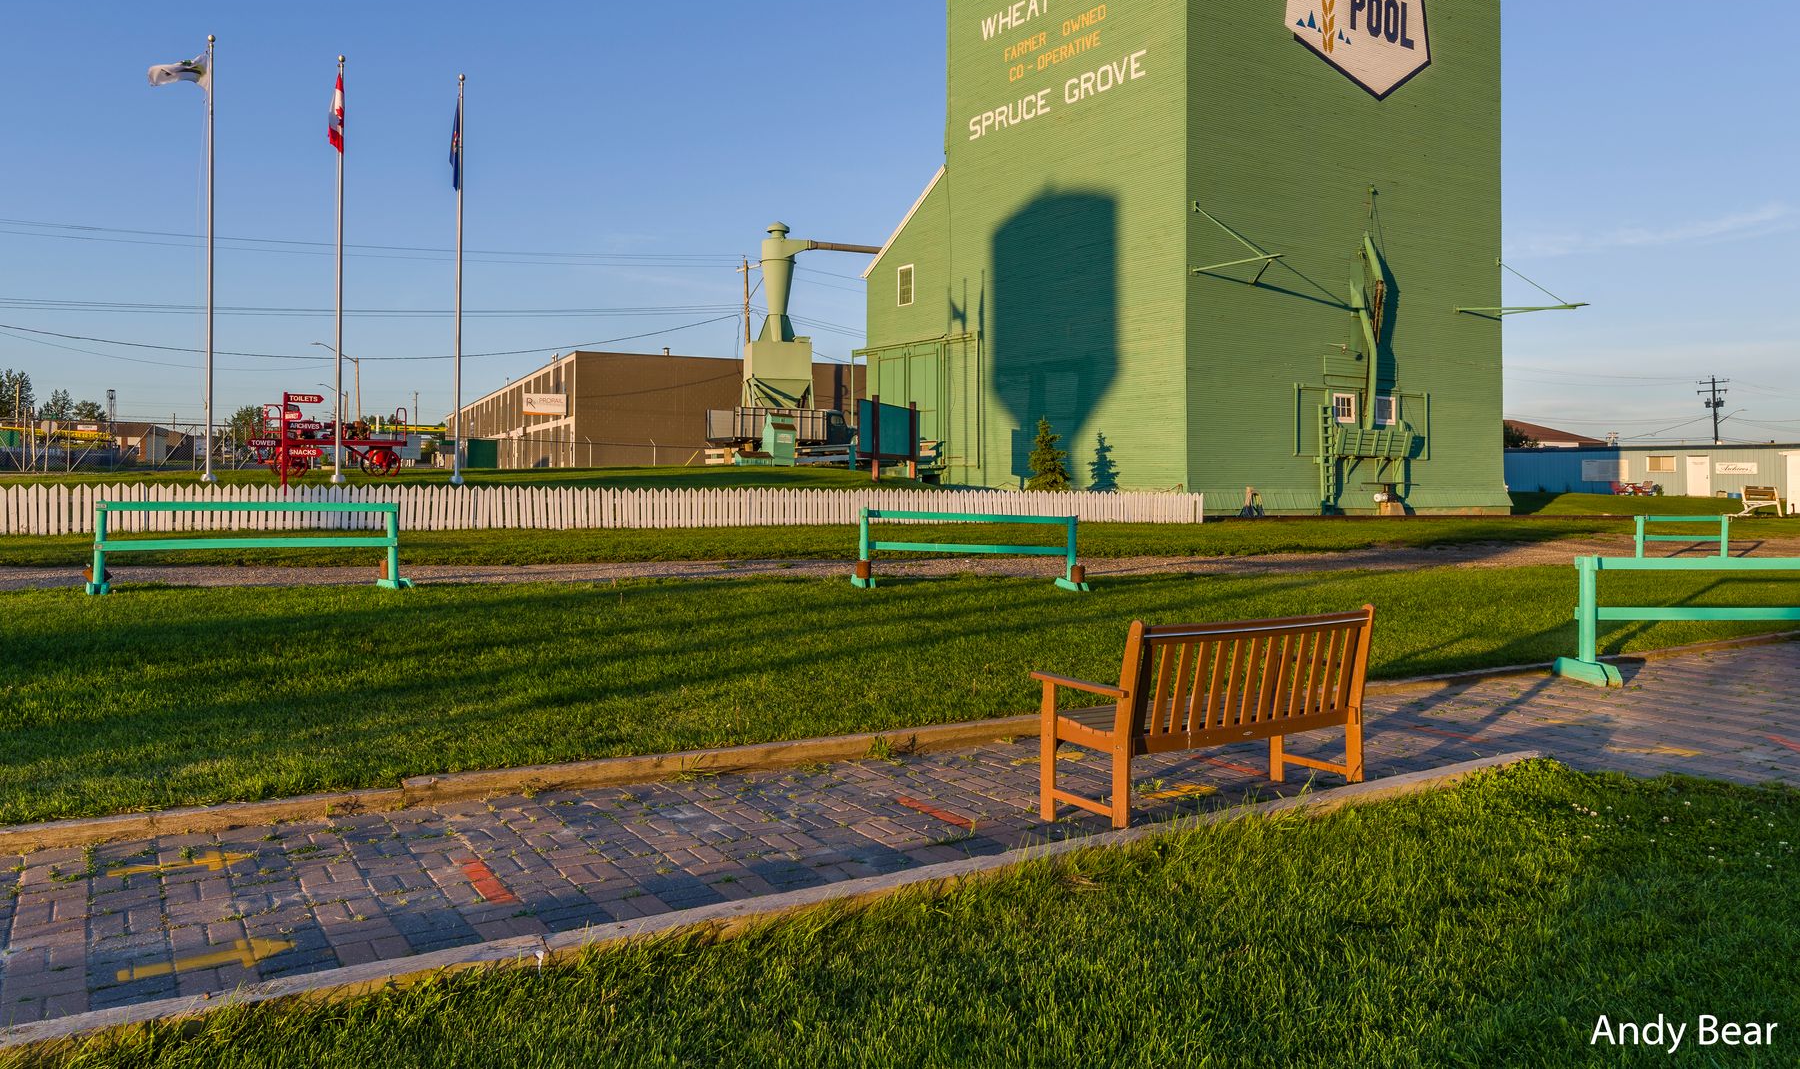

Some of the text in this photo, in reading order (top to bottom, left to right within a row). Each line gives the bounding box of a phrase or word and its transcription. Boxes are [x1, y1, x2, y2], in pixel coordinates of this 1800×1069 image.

[1004, 4, 1107, 63] FARMER OWNED
[969, 49, 1147, 141] SPRUCE GROVE
[290, 422, 320, 430] ARCHIVES
[289, 448, 317, 456] SNACKS
